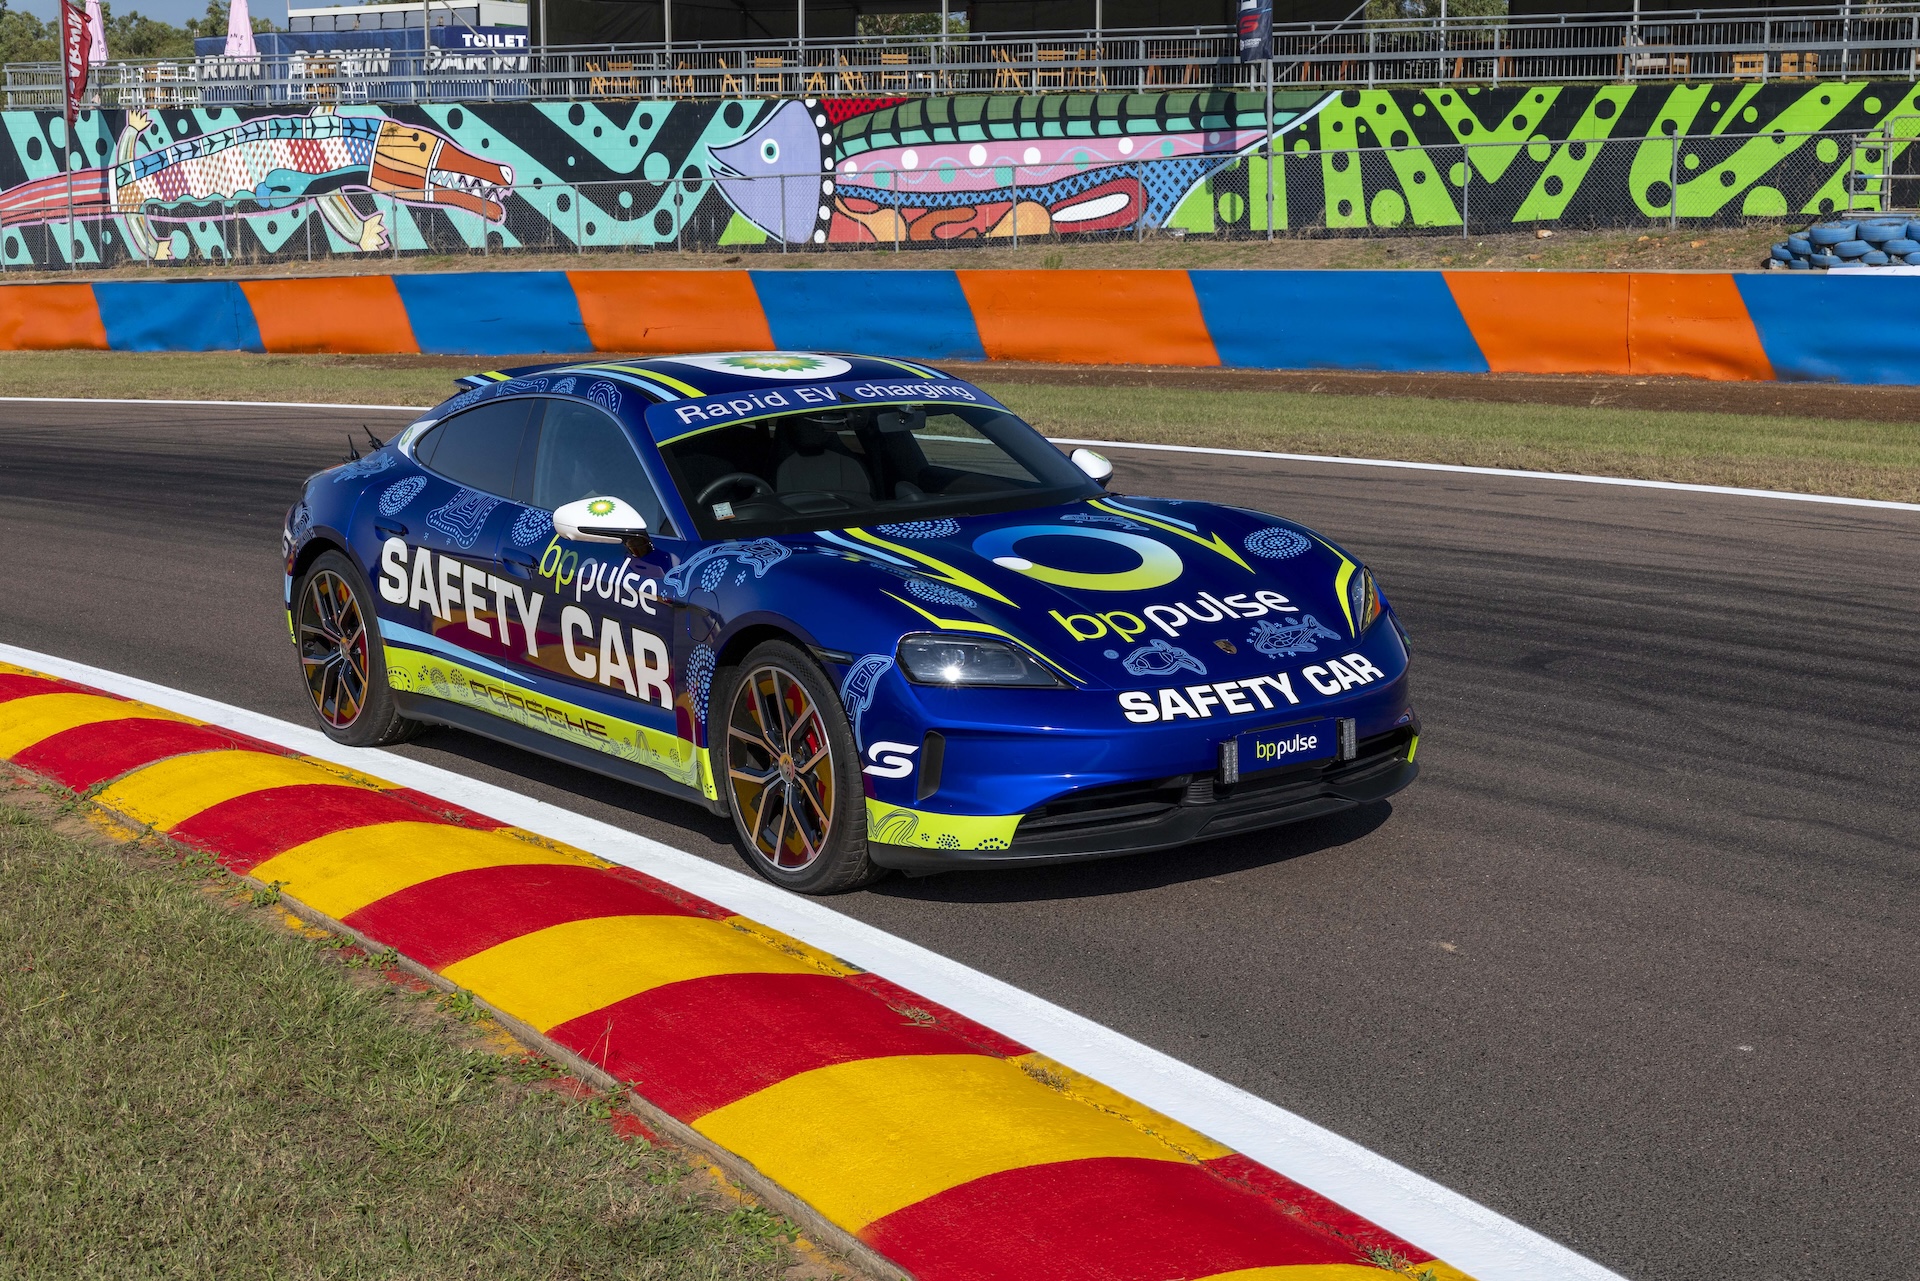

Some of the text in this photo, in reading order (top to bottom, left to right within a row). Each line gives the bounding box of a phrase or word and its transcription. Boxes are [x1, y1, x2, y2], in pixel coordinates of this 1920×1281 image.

[675, 382, 977, 425] Rapid EV charging
[378, 536, 674, 711] SAFETY CAR
[1118, 652, 1385, 724] SAFETY CAR
